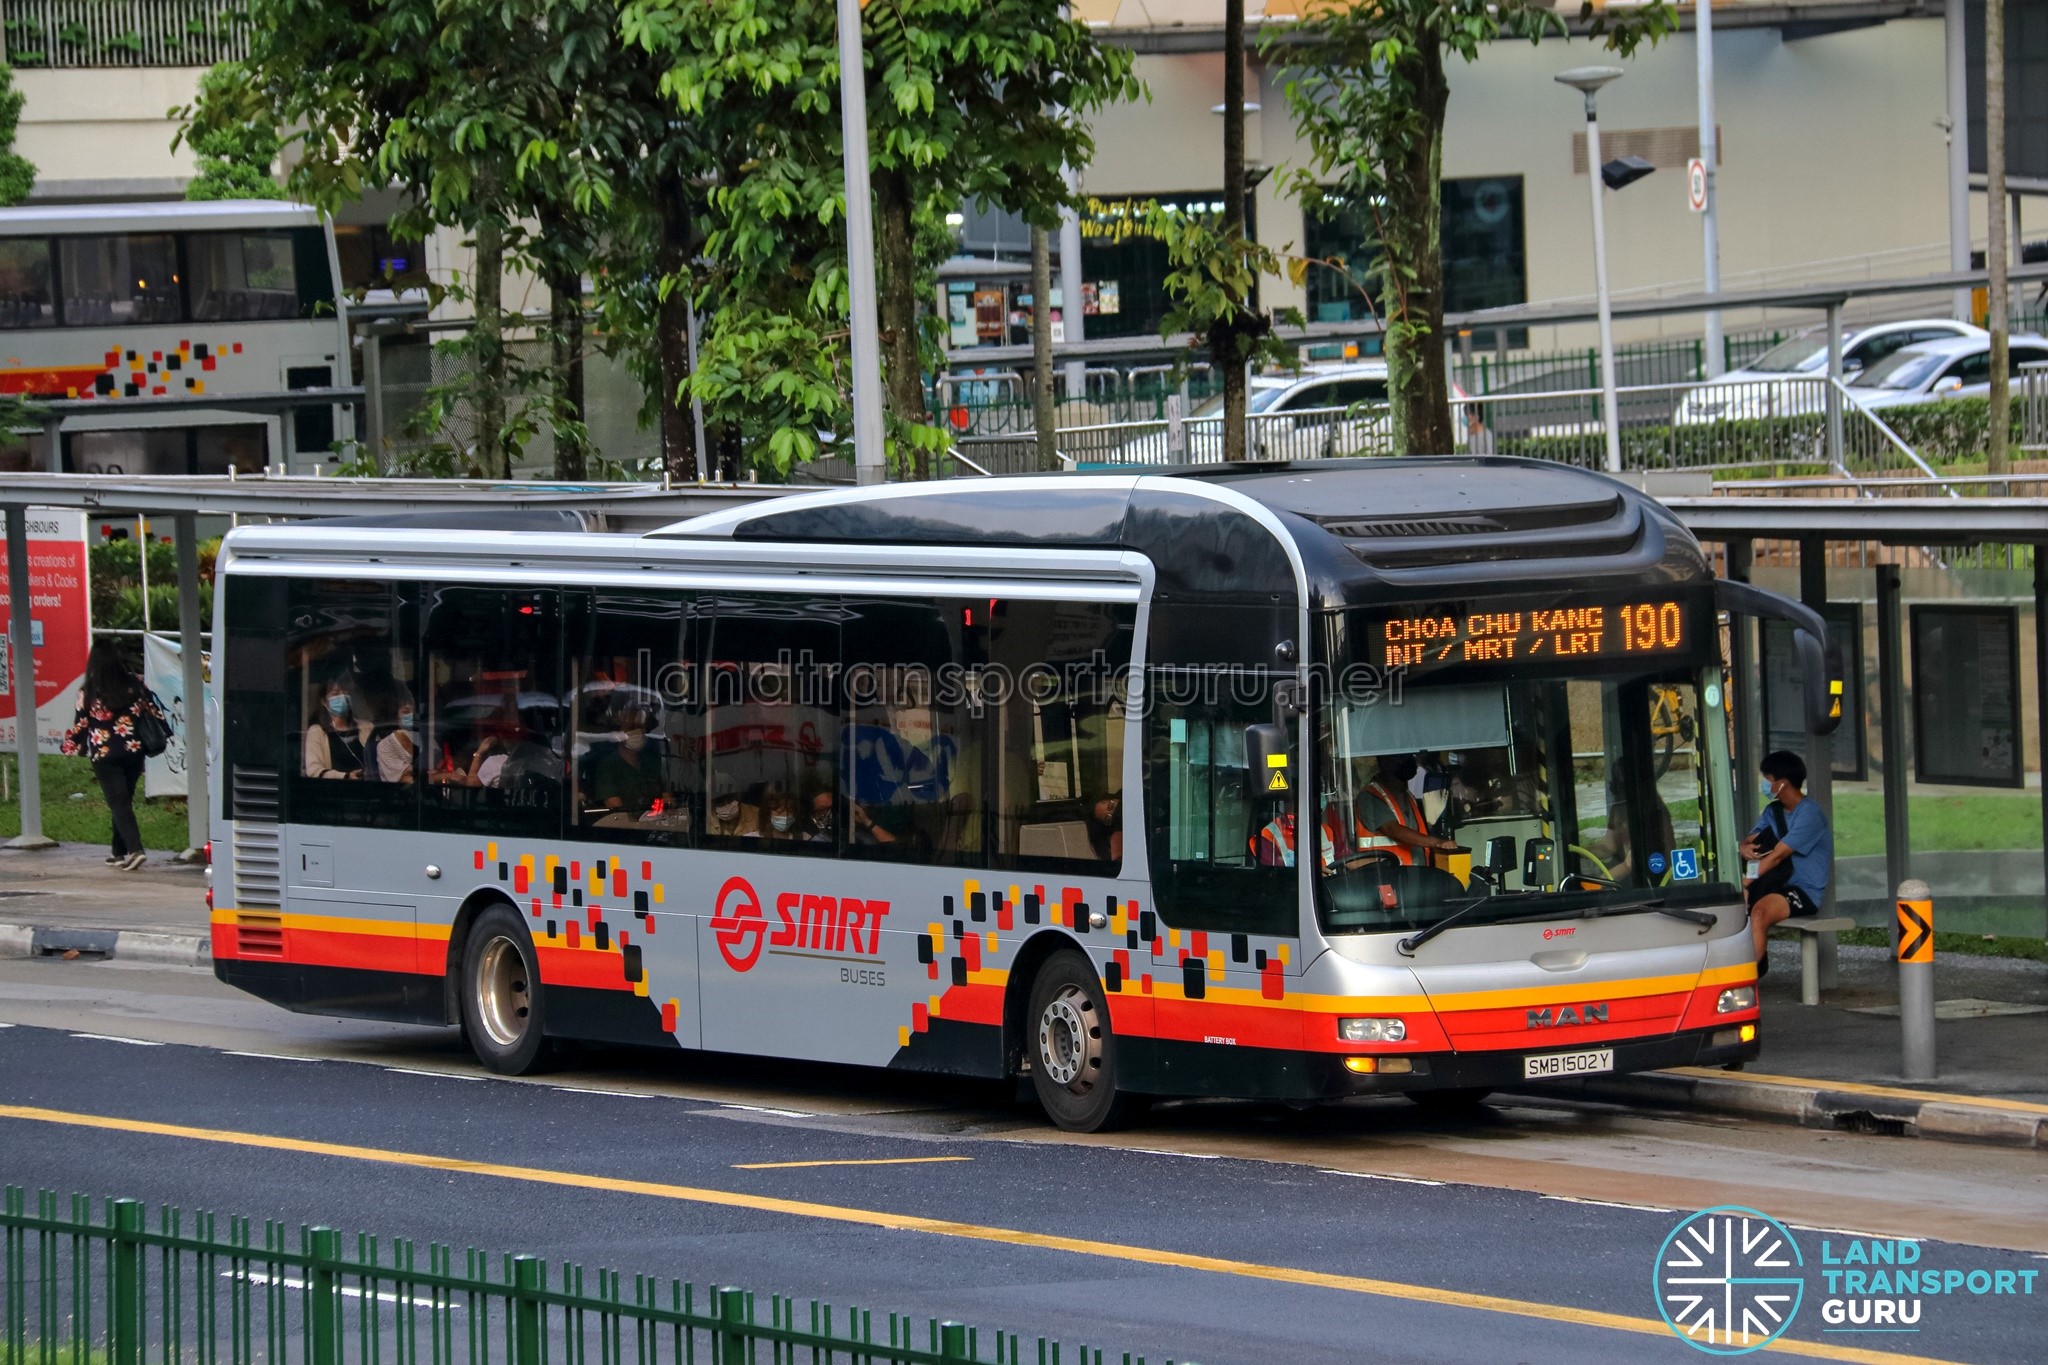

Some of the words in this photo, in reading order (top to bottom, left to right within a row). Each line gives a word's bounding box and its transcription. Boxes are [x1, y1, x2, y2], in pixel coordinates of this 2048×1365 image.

[34, 553, 66, 568] creations
[53, 573, 78, 588] Cooks
[34, 593, 61, 608] orders!
[1385, 617, 1456, 641] CHOA
[1468, 613, 1520, 636] CHU
[1532, 607, 1603, 632] KANG
[1620, 602, 1681, 650] 190
[1386, 643, 1425, 666] INT
[1438, 644, 1453, 660] /
[1464, 638, 1517, 660] MRT
[1529, 638, 1544, 654] /
[1555, 631, 1603, 655] LRT
[770, 892, 891, 955] SMRT
[1554, 927, 1576, 937] SMRT
[840, 967, 886, 987] BUSES
[1526, 1003, 1609, 1029] MAN
[1204, 1035, 1225, 1045] BATTERY
[1225, 1037, 1237, 1046] BOX
